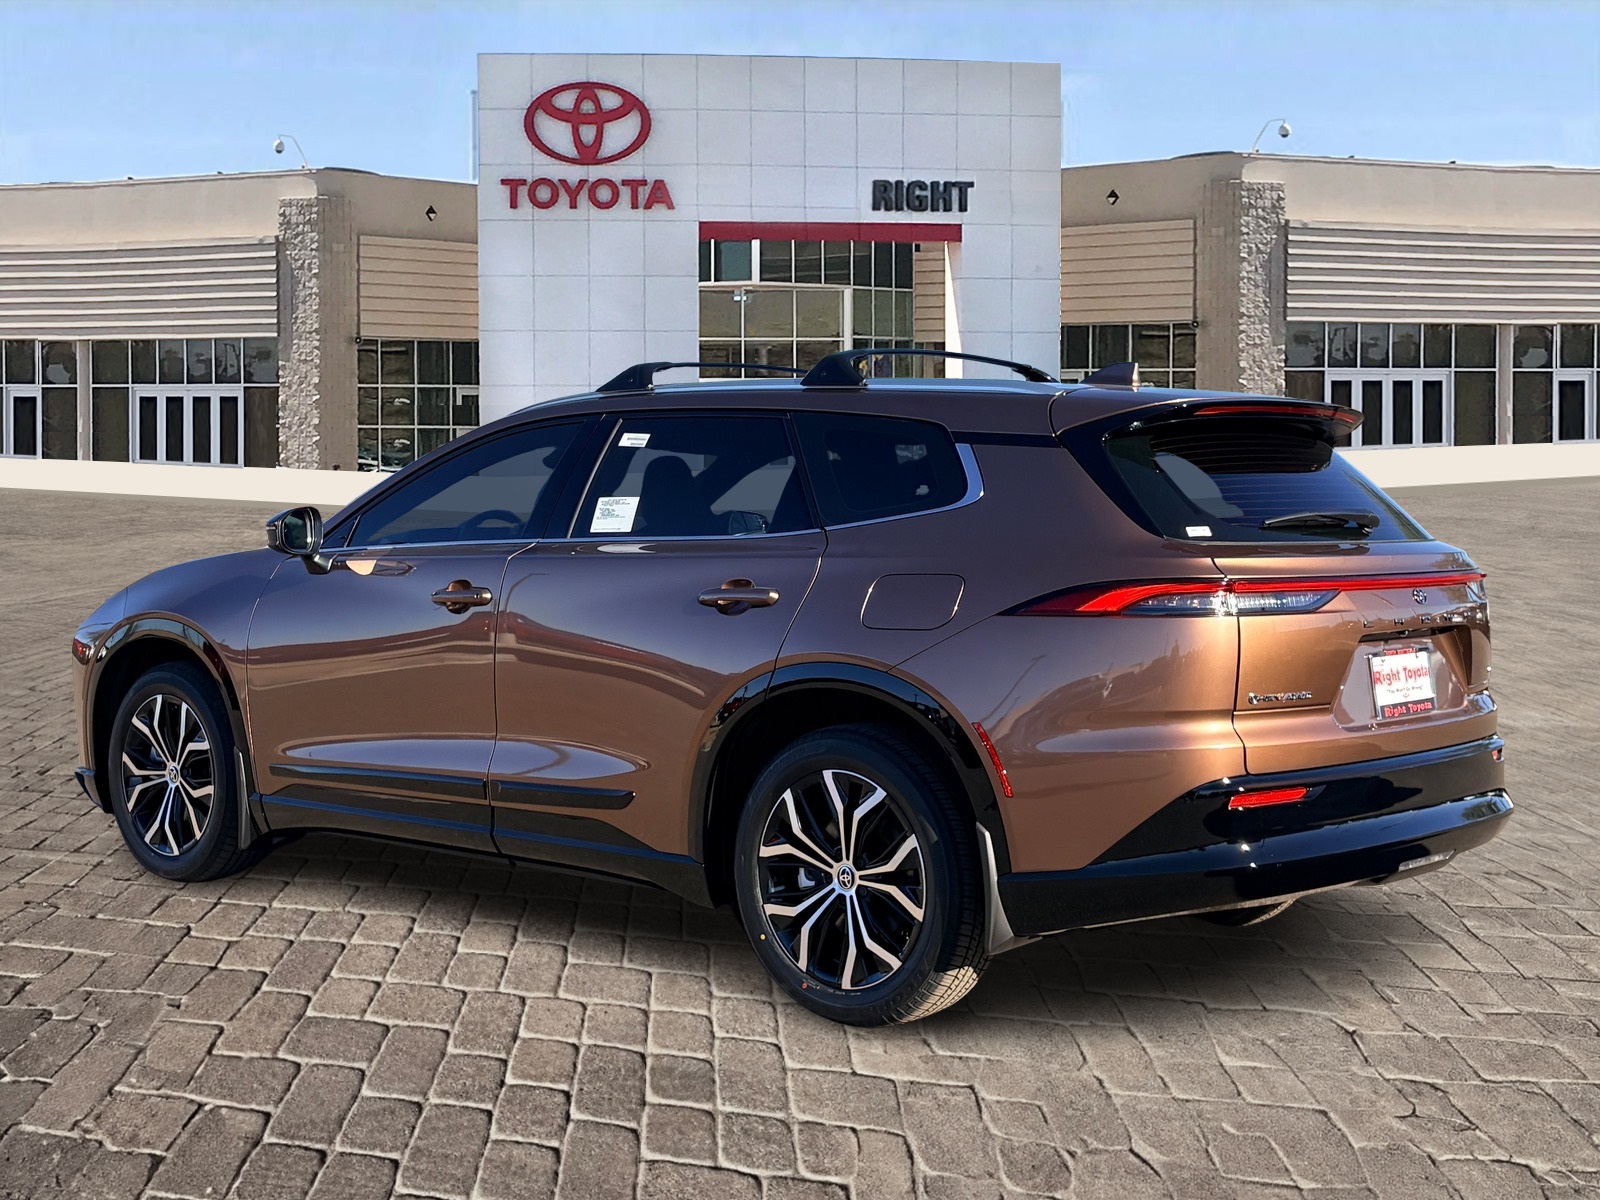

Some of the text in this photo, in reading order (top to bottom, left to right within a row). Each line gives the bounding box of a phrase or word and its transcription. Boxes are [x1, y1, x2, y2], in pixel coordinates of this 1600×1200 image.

[500, 178, 675, 210] TOYOTA
[871, 179, 975, 213] RIGHT
[1373, 665, 1429, 686] Right Toyota
[1384, 701, 1433, 718] Right Toyota
